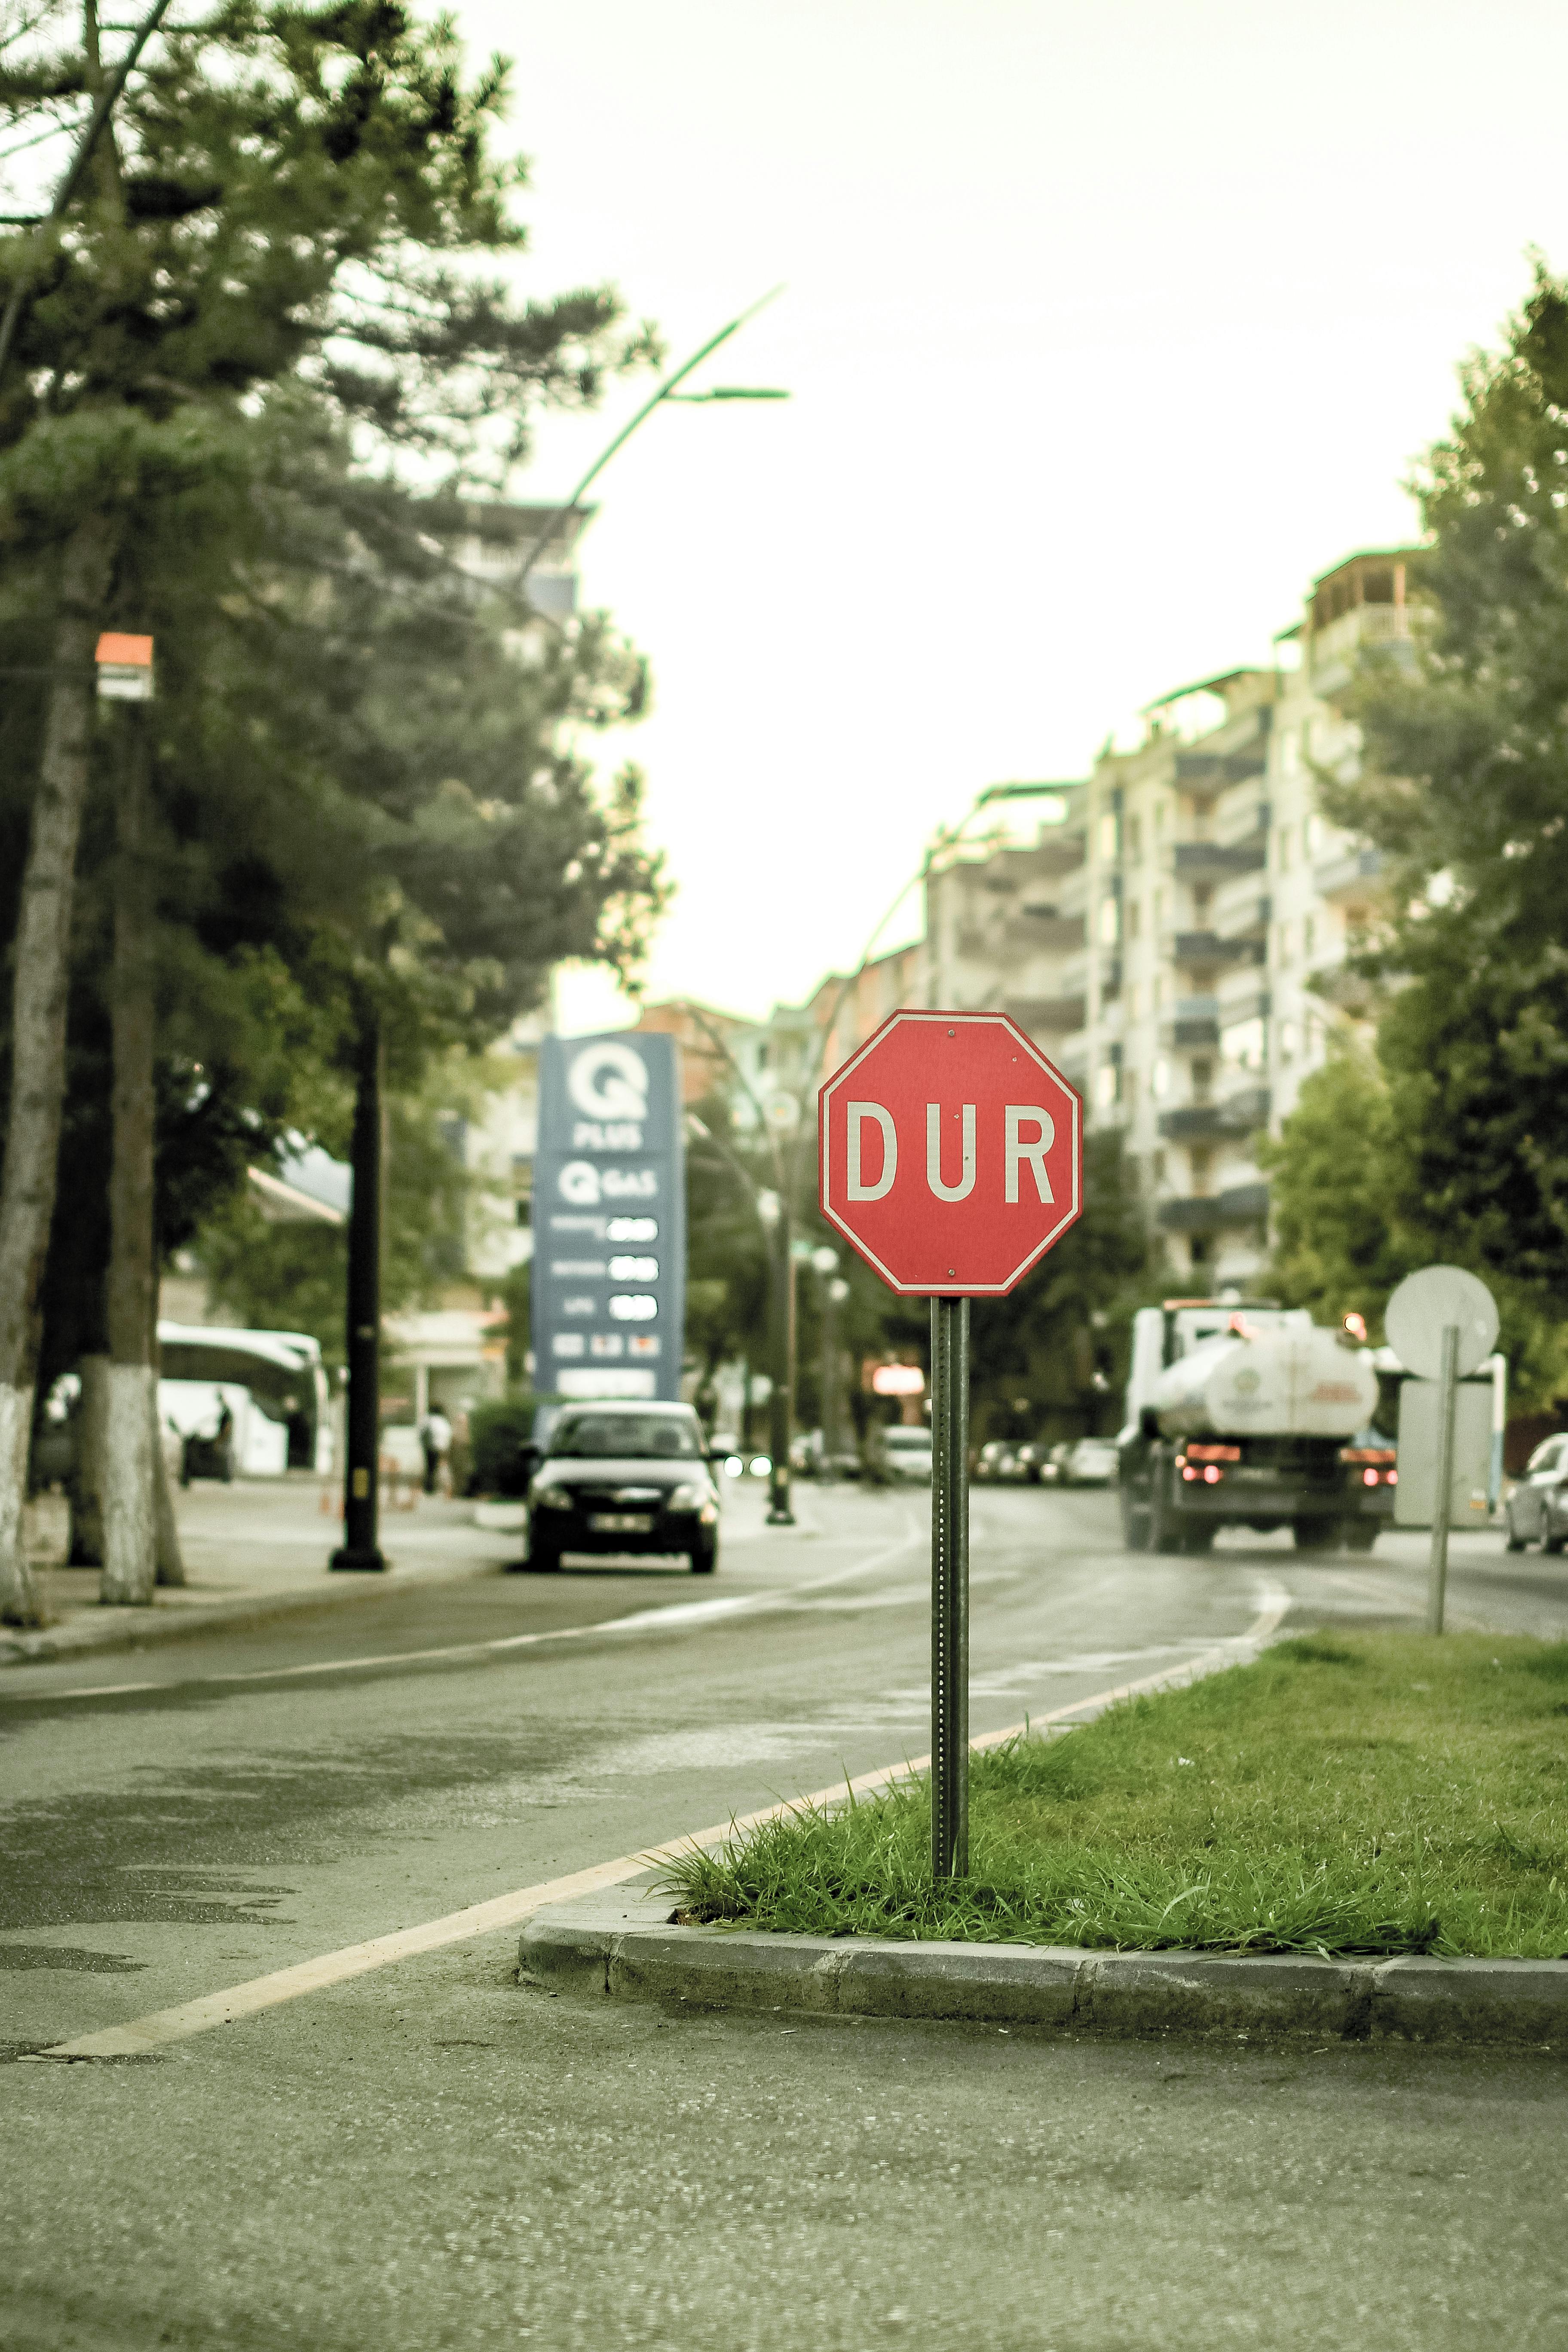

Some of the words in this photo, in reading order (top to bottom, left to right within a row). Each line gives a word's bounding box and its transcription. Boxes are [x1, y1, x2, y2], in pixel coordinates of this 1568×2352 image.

[570, 1042, 649, 1118] Q
[559, 1160, 600, 1204] Q
[603, 1169, 658, 1197] GAS
[847, 1101, 1056, 1204] DUR
